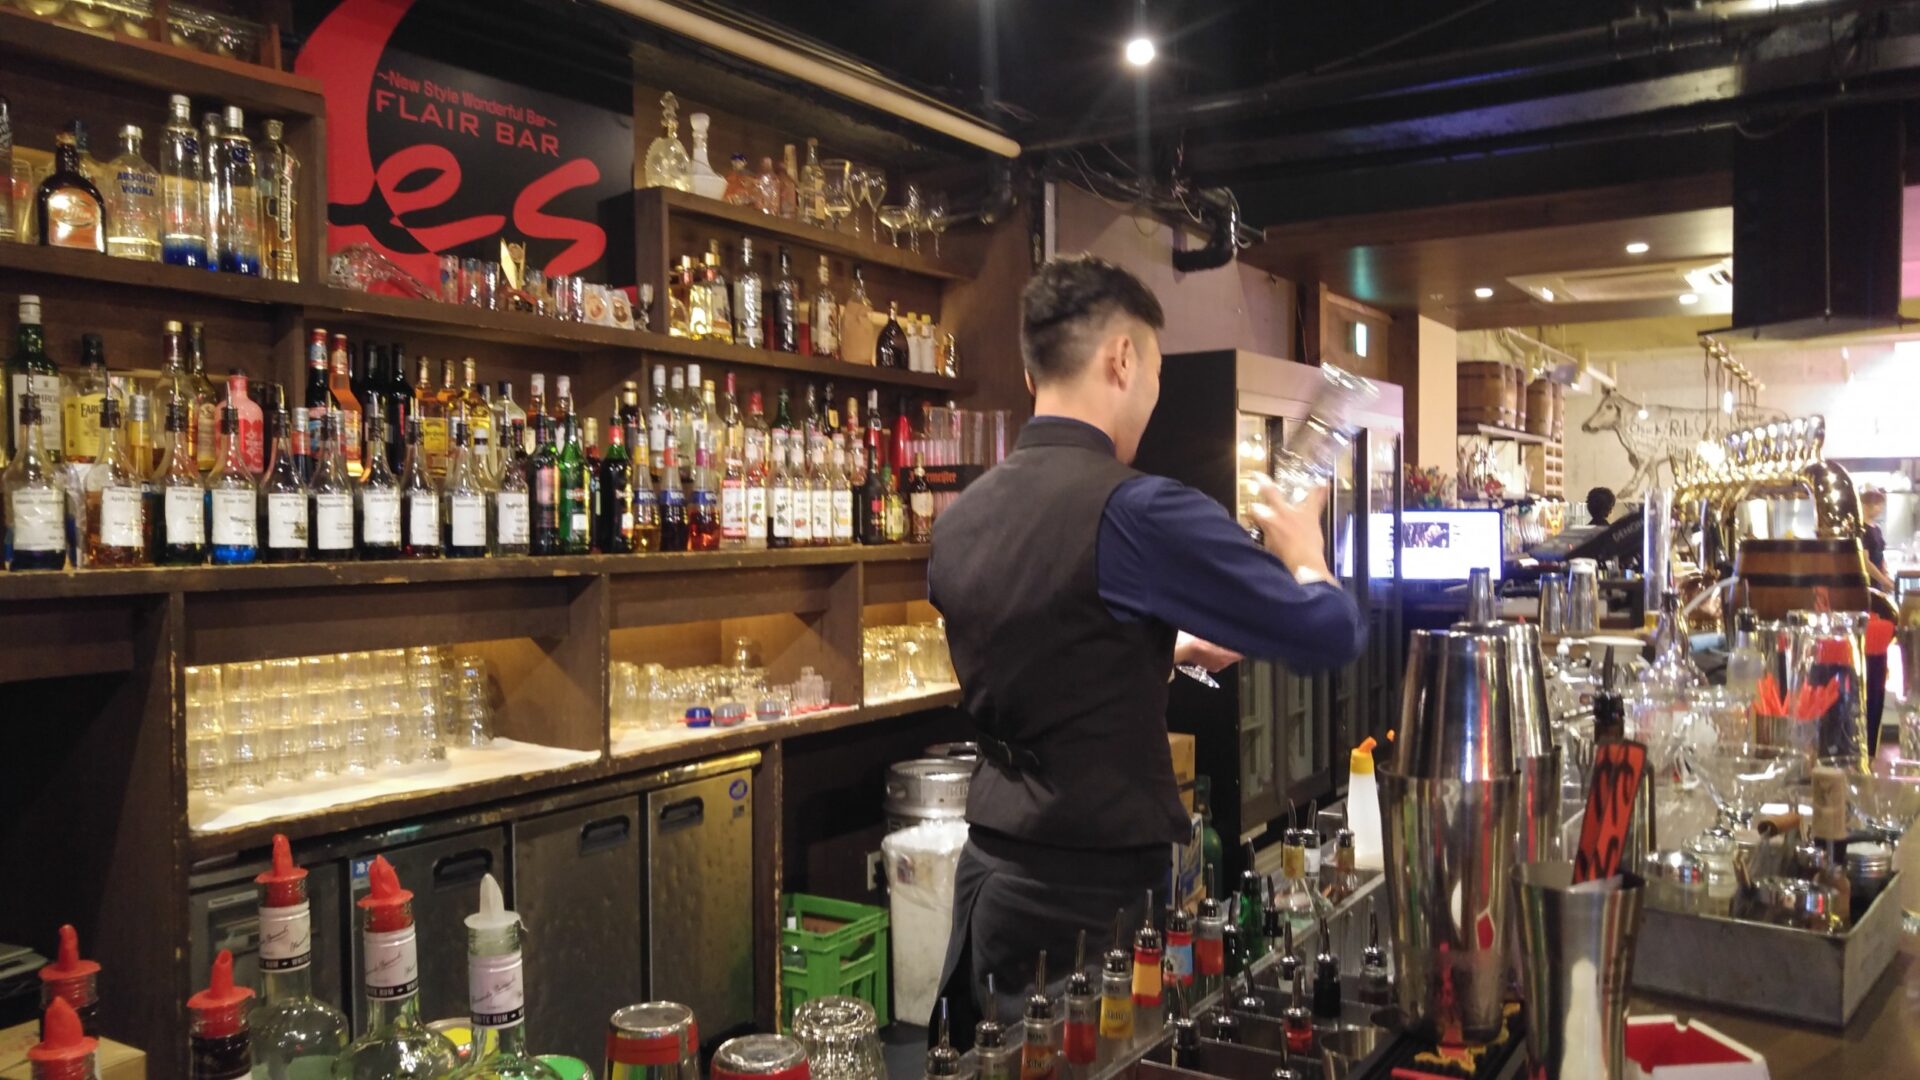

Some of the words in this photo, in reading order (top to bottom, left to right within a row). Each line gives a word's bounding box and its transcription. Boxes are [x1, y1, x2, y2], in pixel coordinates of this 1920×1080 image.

[423, 79, 460, 103] Style
[462, 91, 524, 122] Wonderful
[375, 89, 480, 137] FLAIR
[495, 121, 560, 158] BAR
[117, 171, 157, 186] ABSOLUT
[121, 184, 154, 196] VODKA
[1669, 418, 1694, 438] Rib
[492, 1013, 508, 1025] RUM
